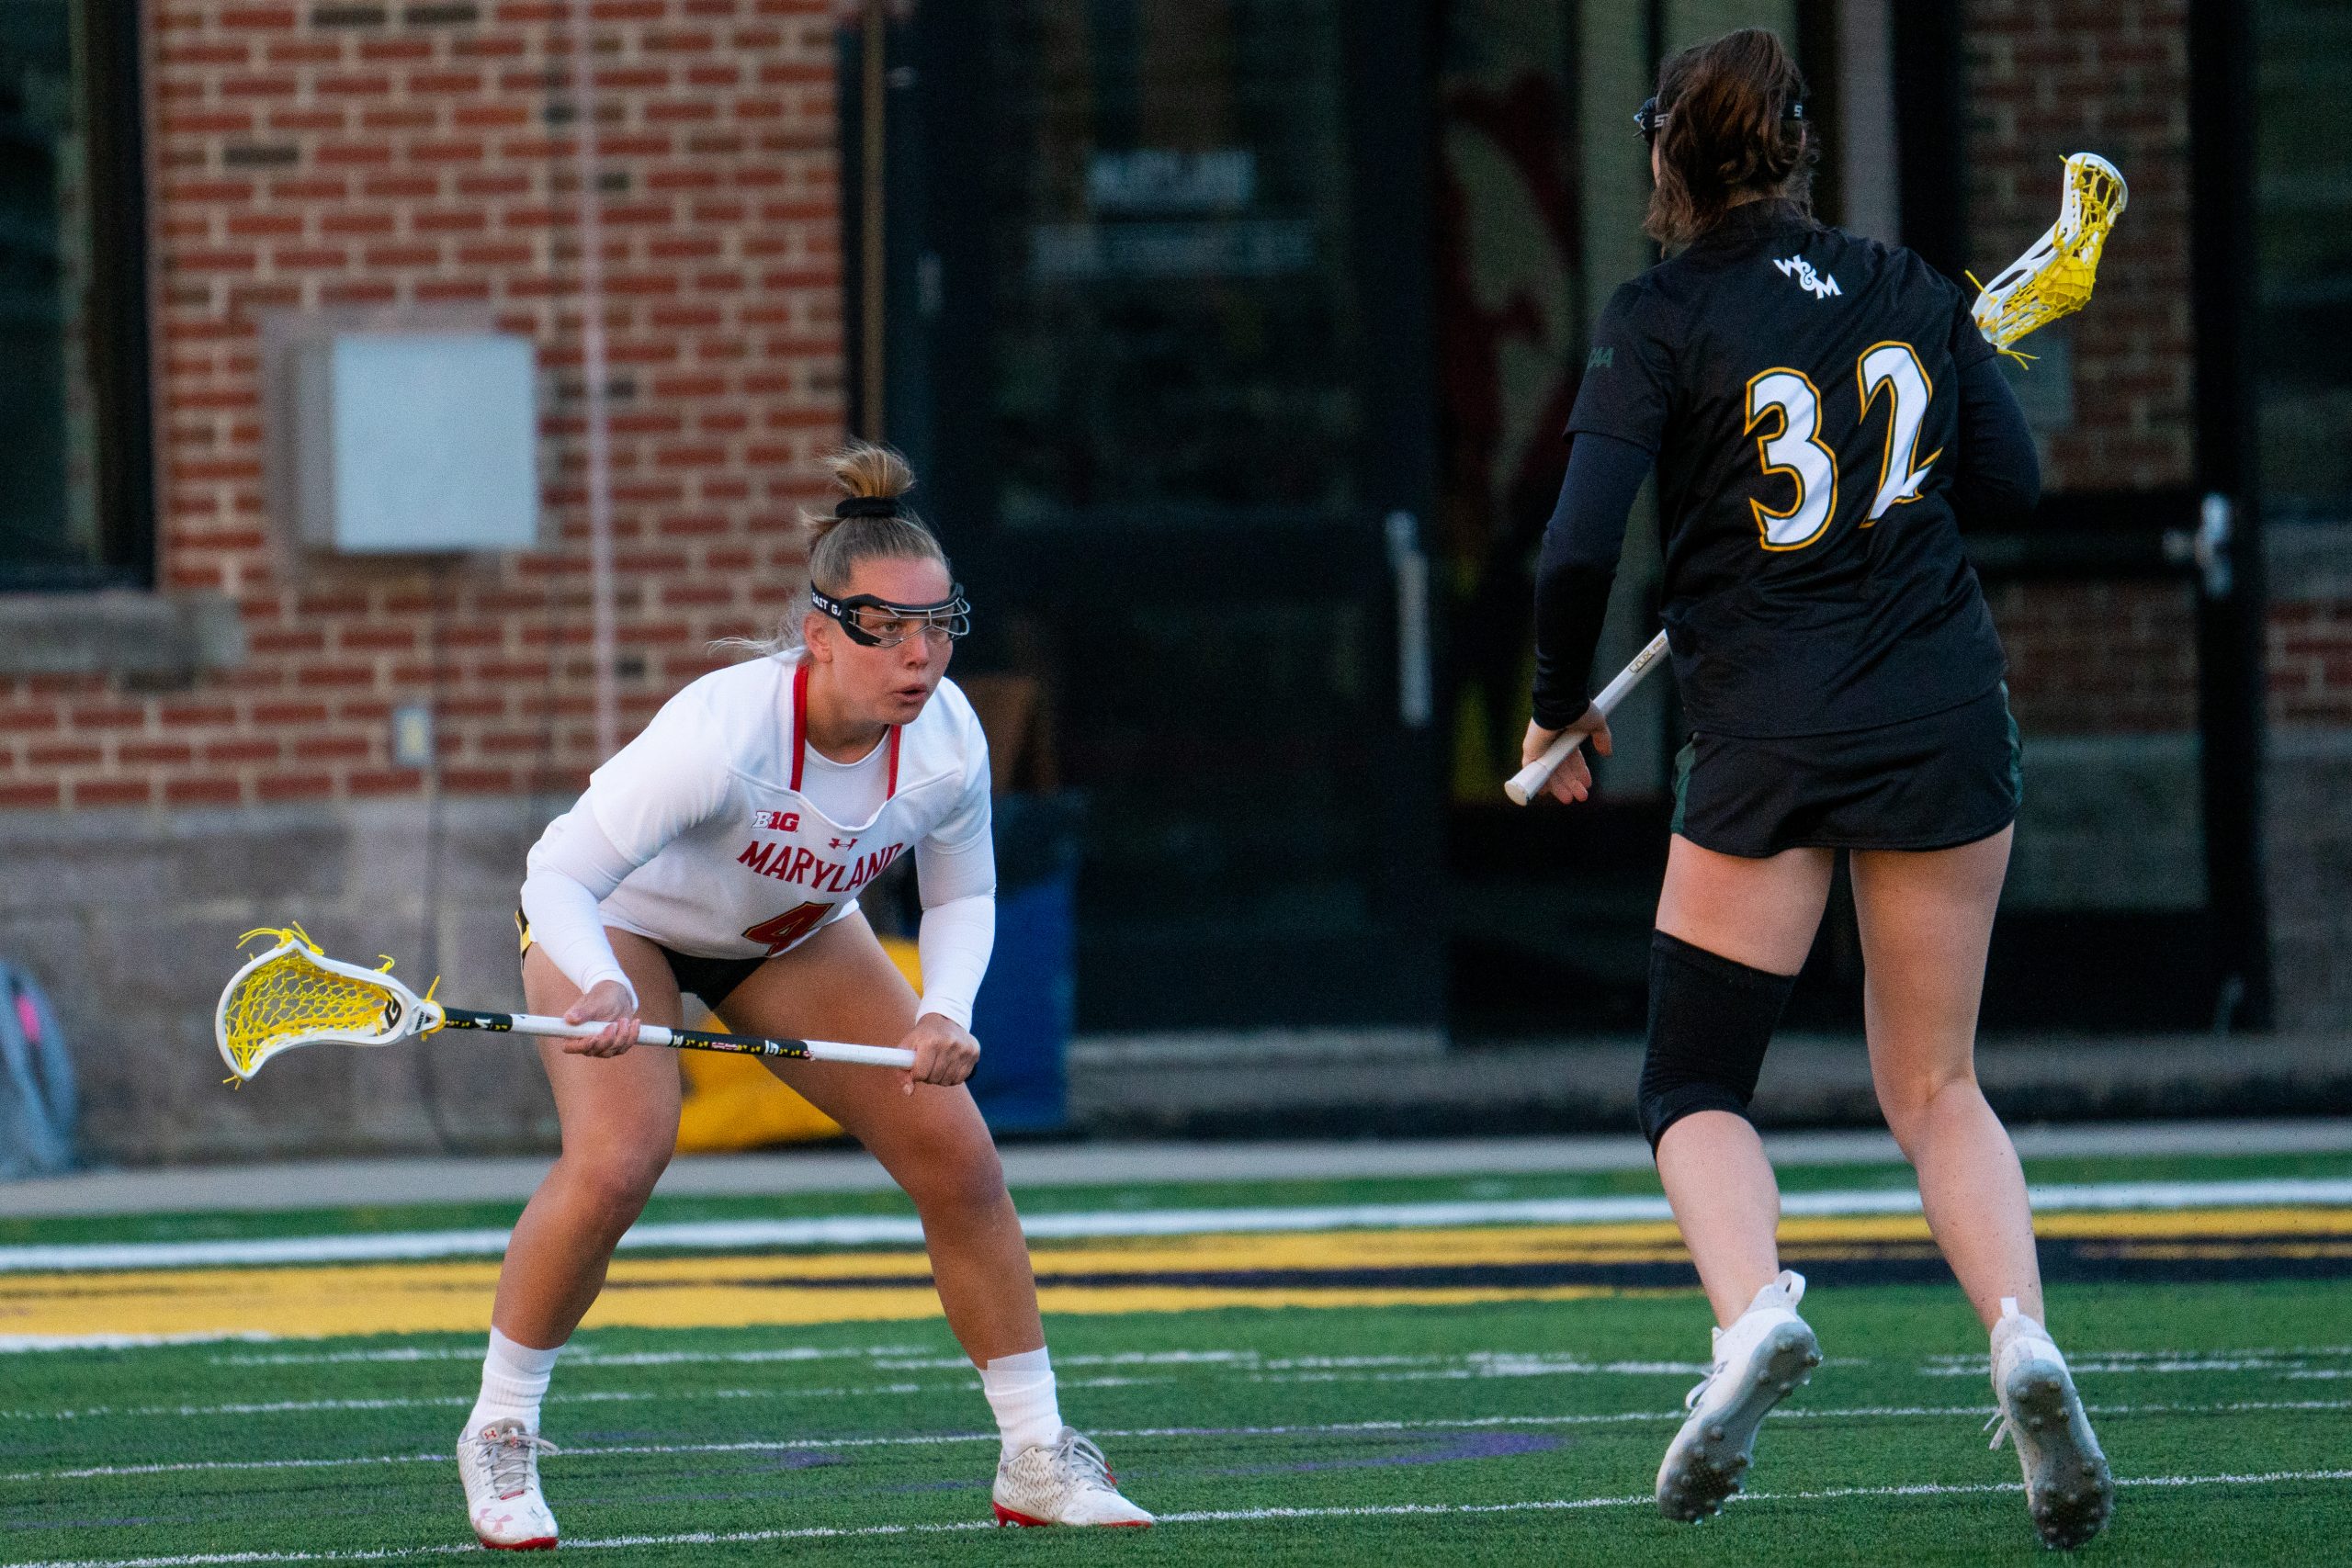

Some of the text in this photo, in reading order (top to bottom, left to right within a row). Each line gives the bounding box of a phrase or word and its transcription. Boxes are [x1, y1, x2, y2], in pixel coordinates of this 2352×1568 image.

[1773, 254, 1843, 300] W&M
[1743, 339, 1944, 552] 32
[736, 840, 904, 893] MARYLAND
[741, 900, 835, 957] 4
